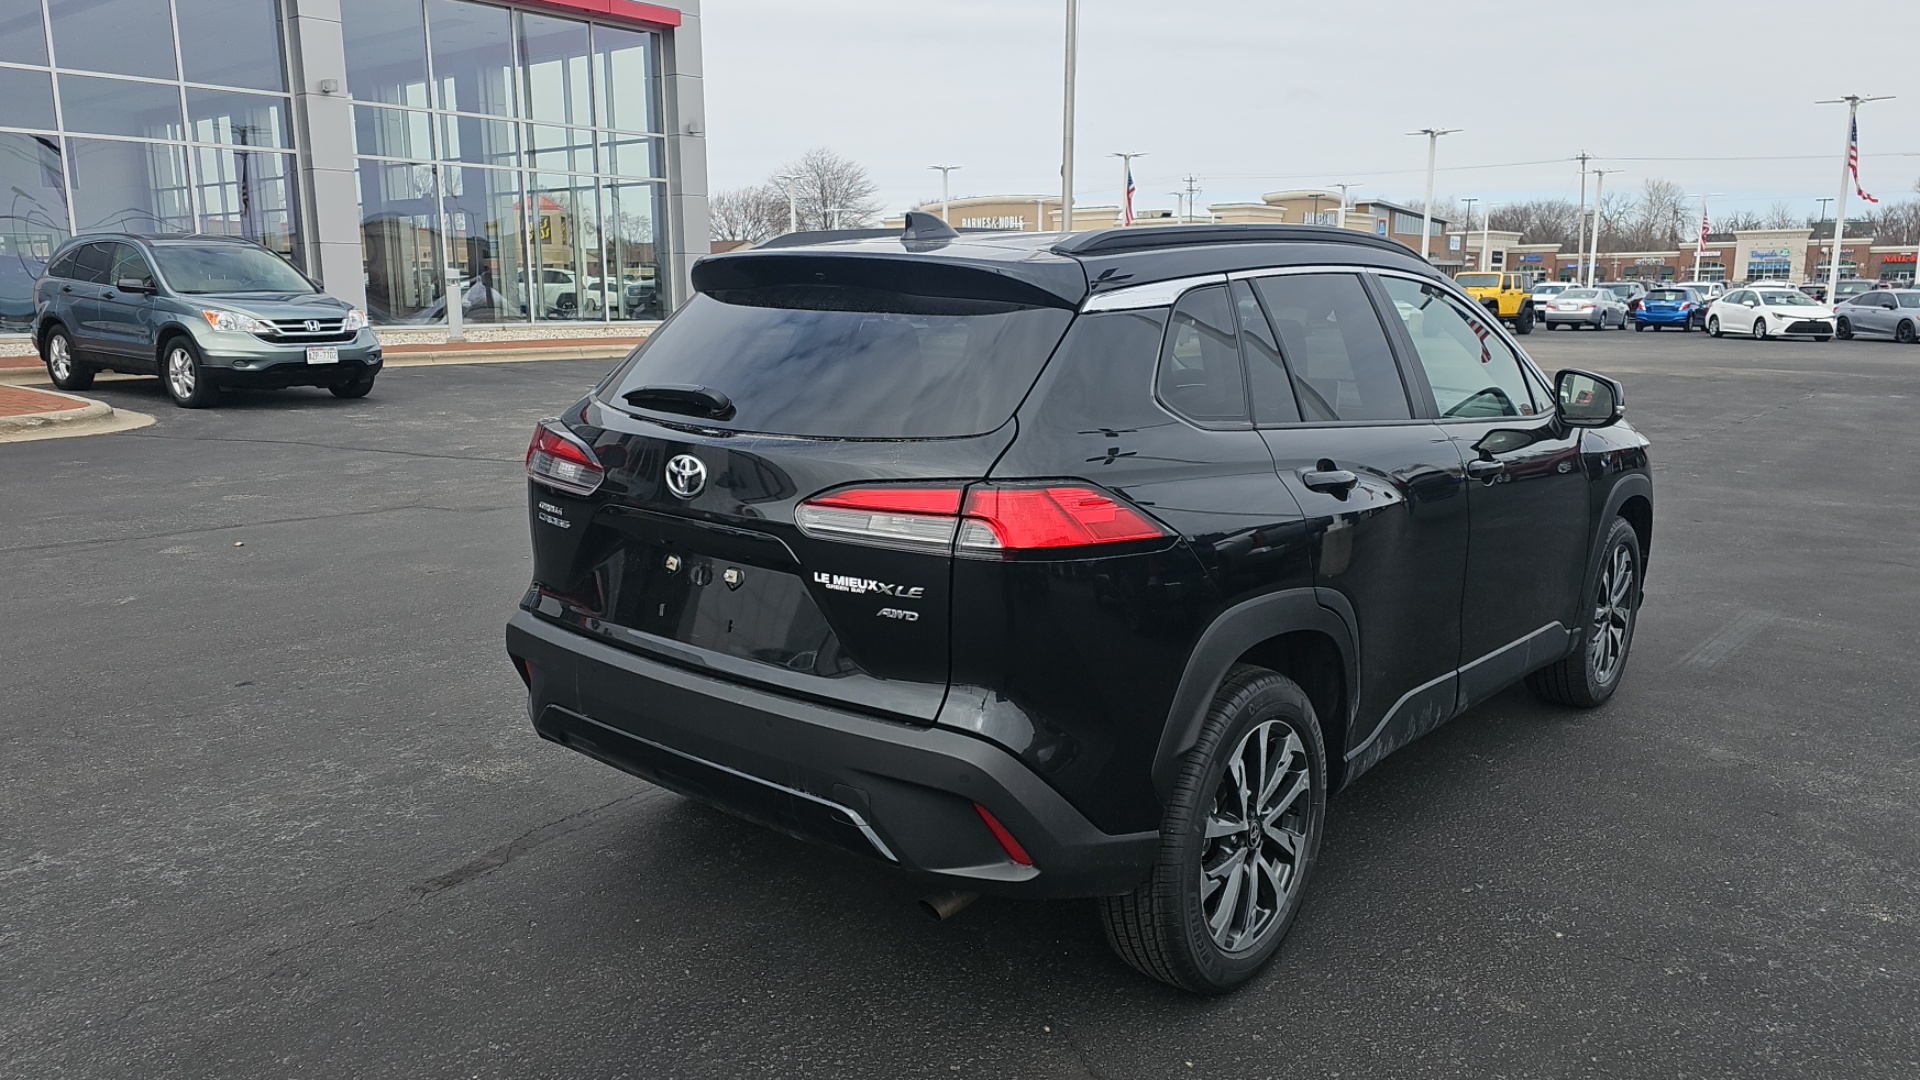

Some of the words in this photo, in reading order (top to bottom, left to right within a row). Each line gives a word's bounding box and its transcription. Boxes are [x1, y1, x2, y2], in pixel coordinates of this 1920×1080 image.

[813, 571, 830, 583] LE
[833, 574, 878, 591] MIEUX
[825, 583, 850, 592] GREEN
[850, 587, 866, 595] BAY
[875, 582, 925, 599] XLE
[876, 607, 920, 622] AWD
[1189, 895, 1212, 966] MICHELIN
